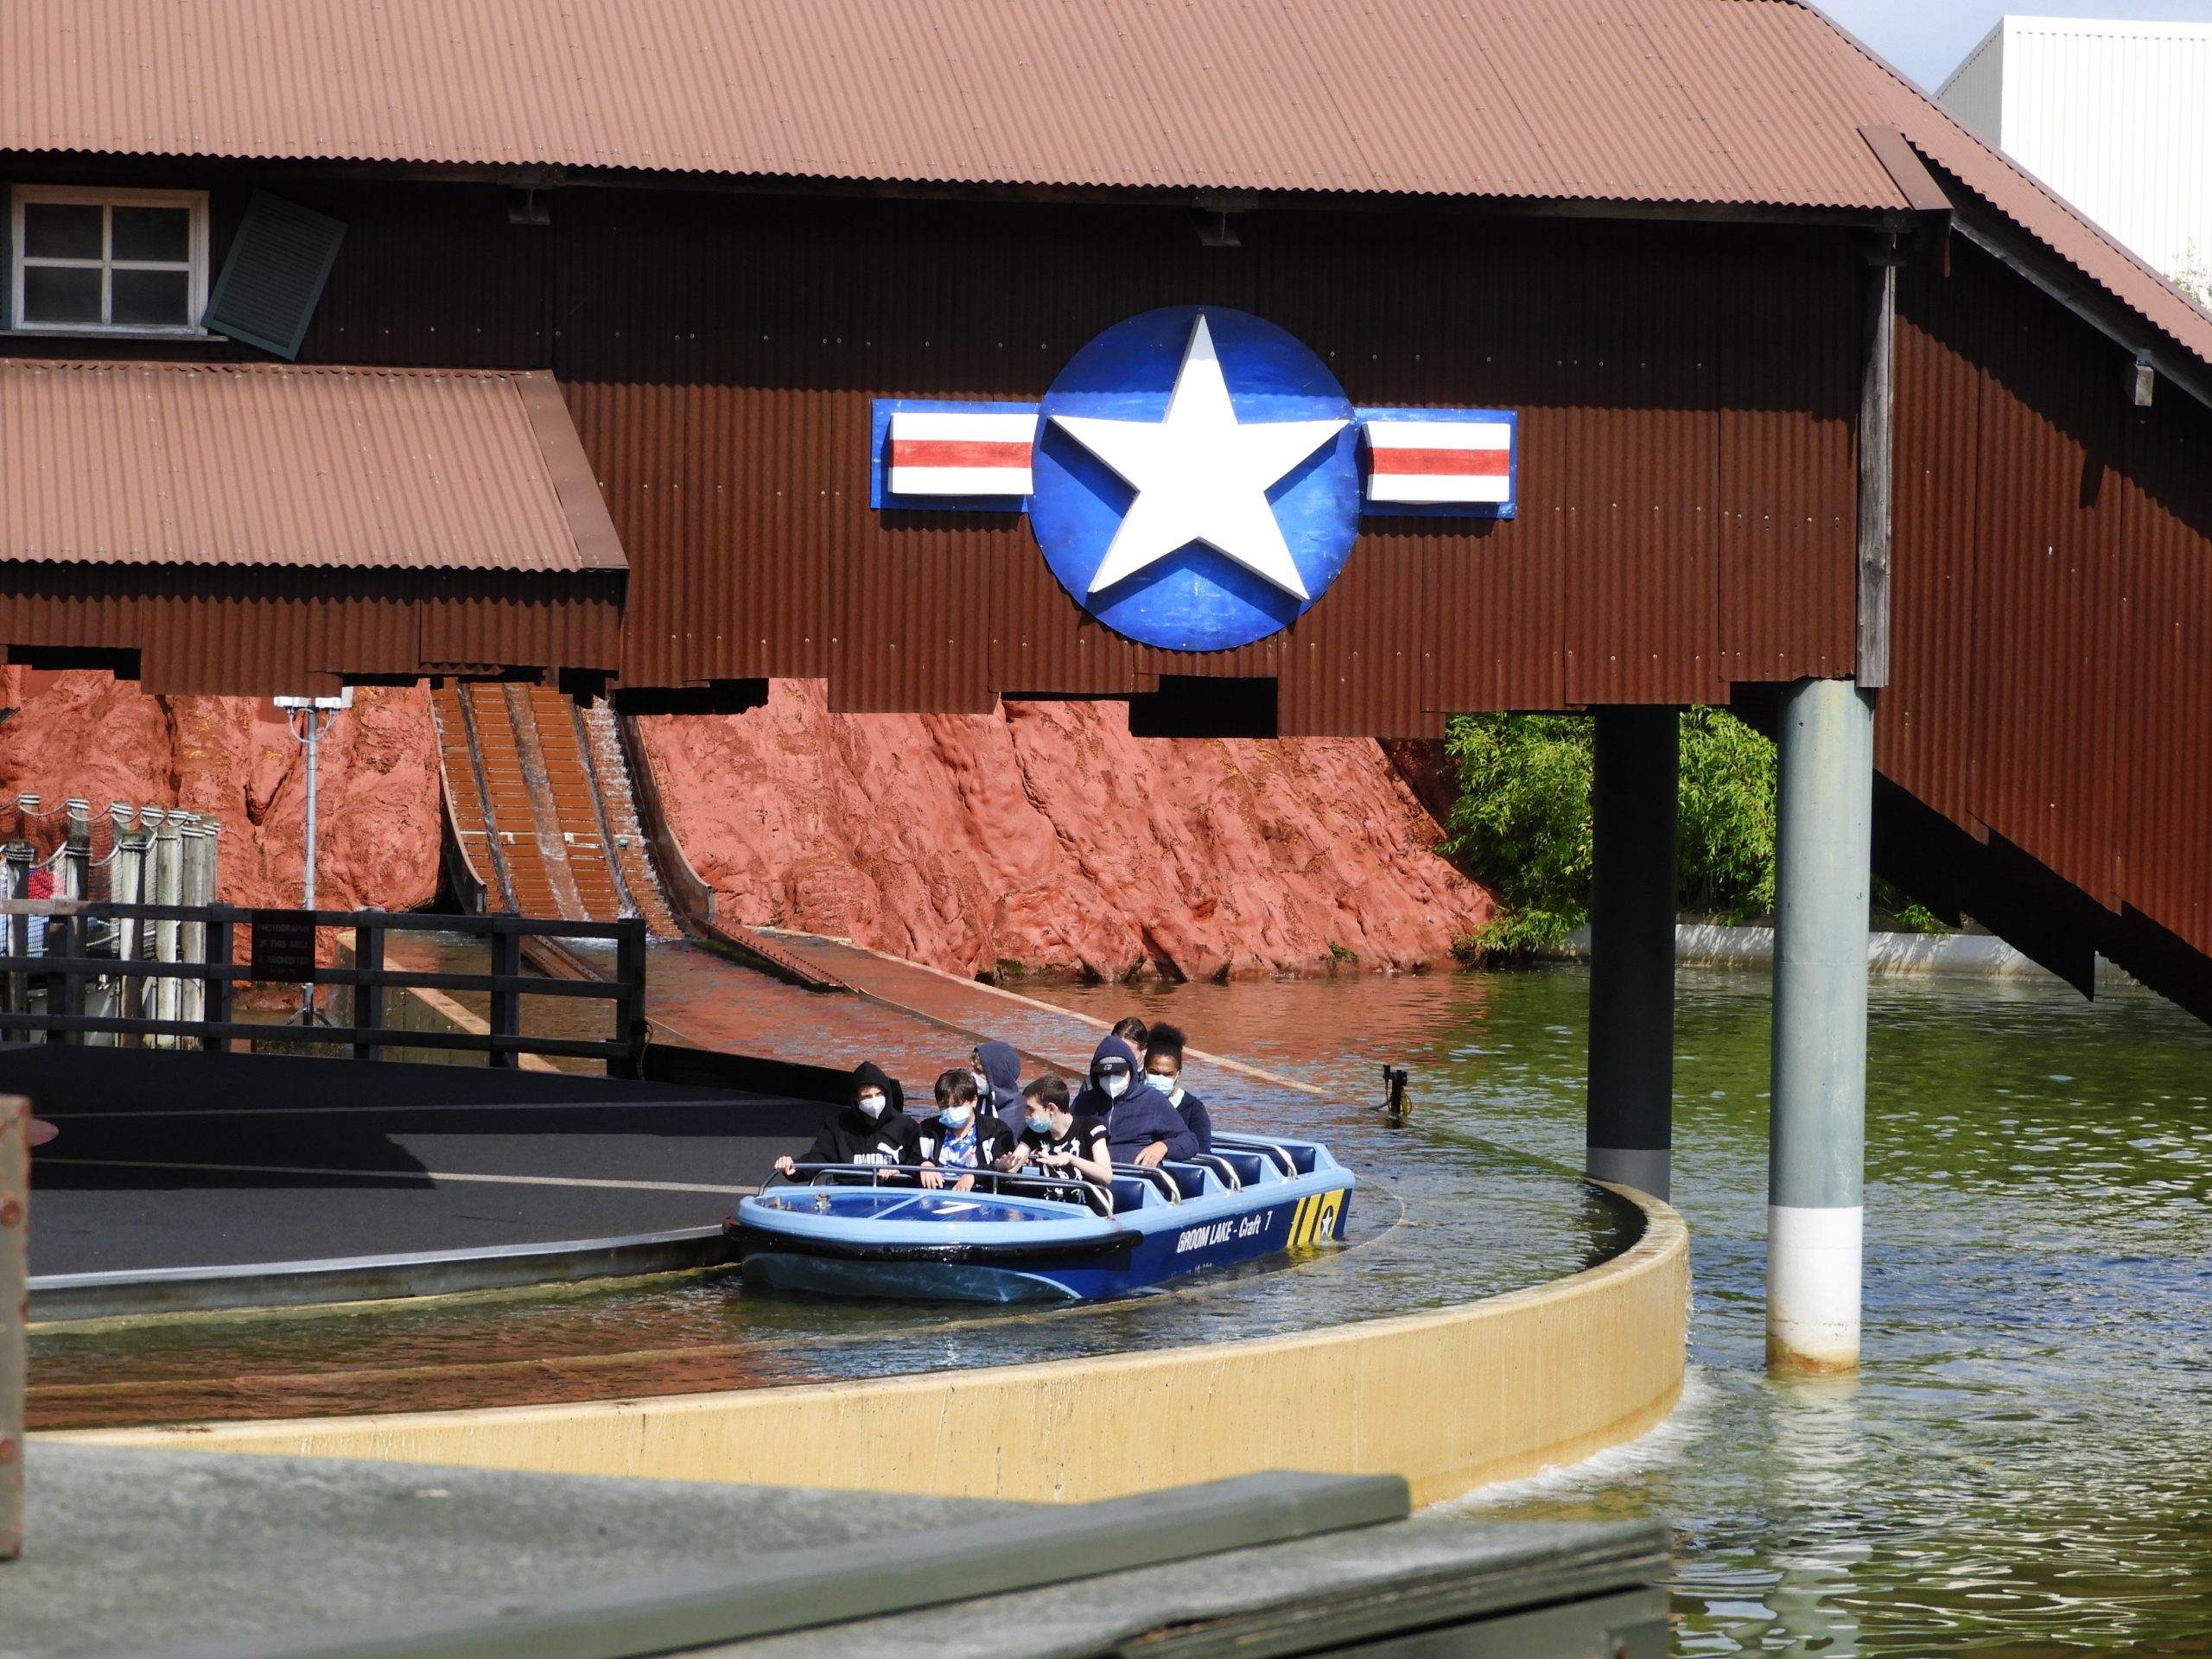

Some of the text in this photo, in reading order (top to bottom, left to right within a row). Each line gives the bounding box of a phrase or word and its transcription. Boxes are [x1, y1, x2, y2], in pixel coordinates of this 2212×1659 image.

[1176, 1225, 1211, 1253] GROOM
[1209, 1220, 1234, 1245] LAKE
[1238, 1214, 1262, 1238] Craft
[1264, 1210, 1273, 1231] 7
